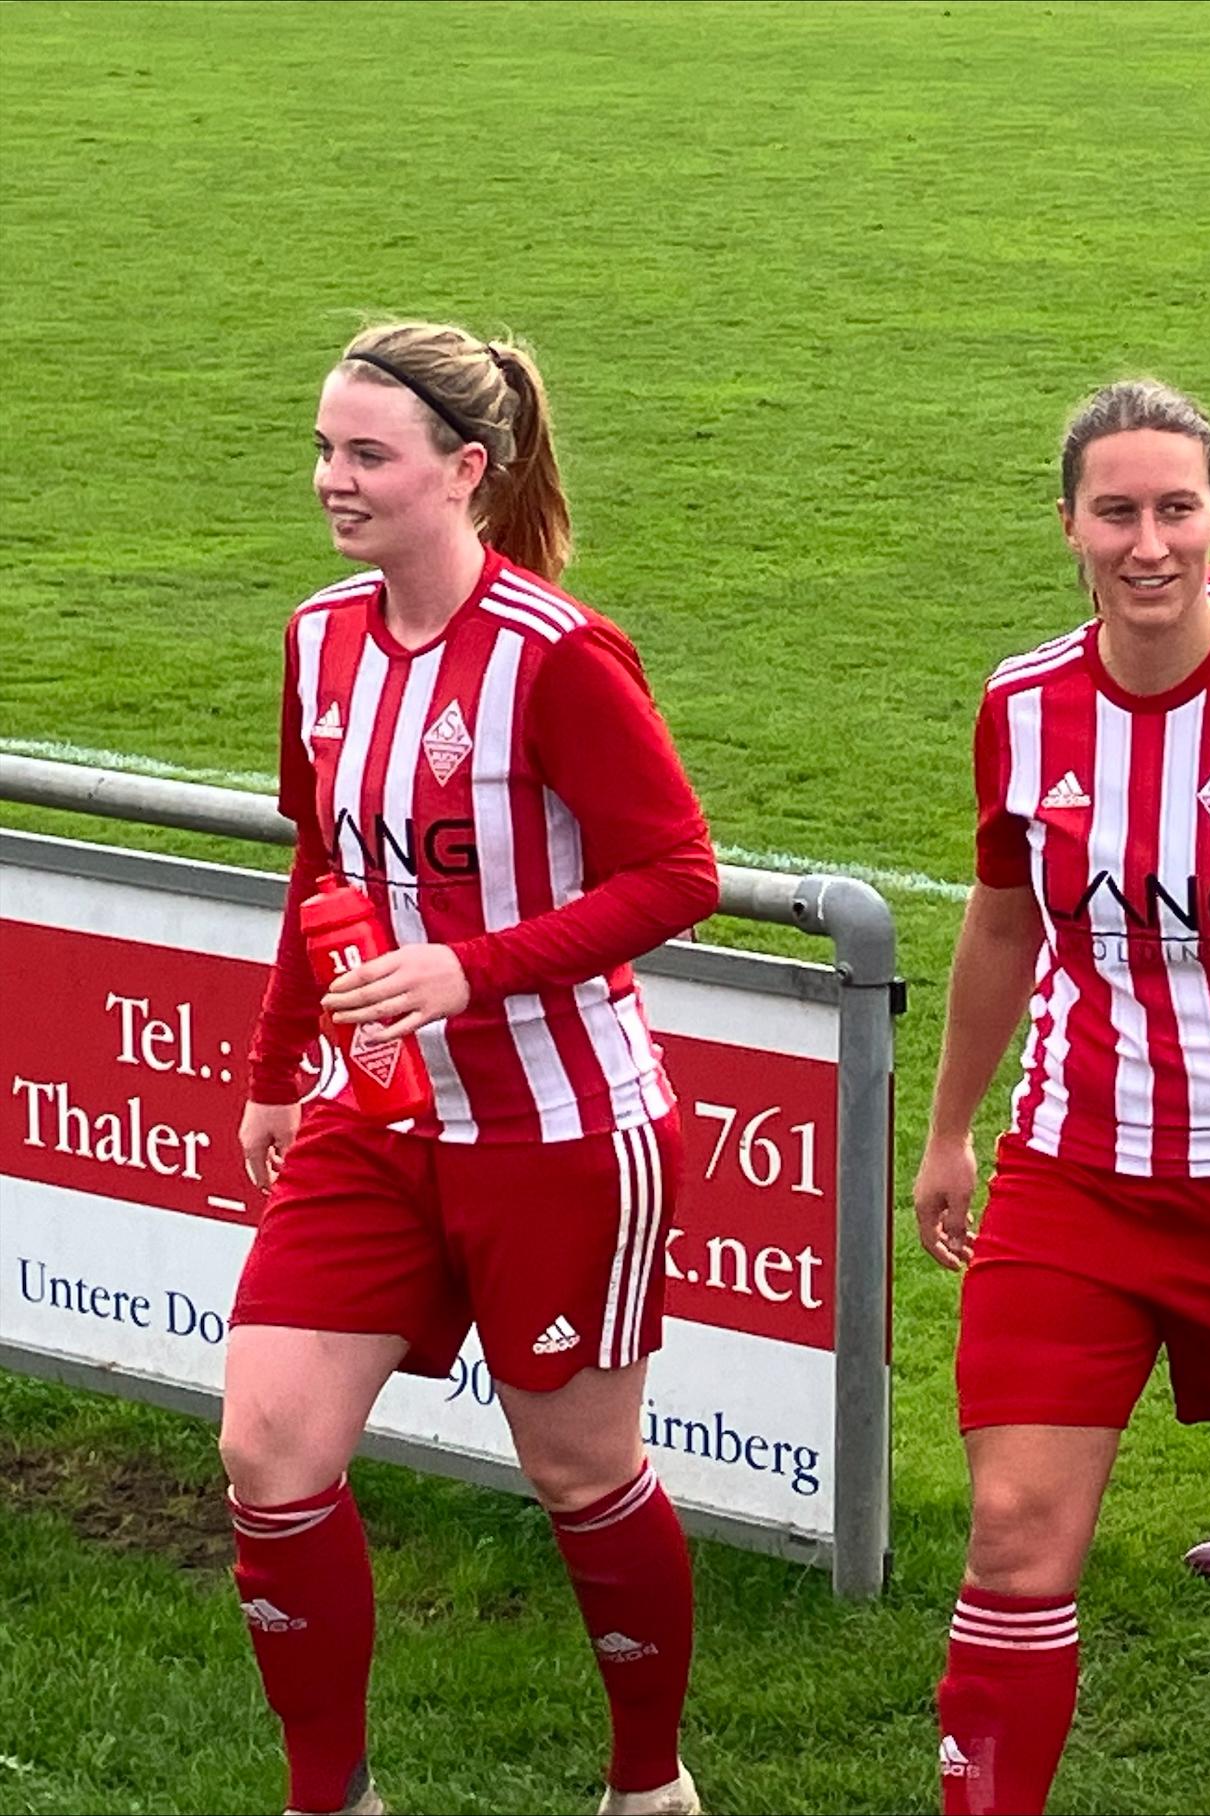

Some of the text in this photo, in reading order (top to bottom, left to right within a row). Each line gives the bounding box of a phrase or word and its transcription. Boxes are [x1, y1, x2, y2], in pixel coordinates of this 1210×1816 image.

[331, 807, 481, 882] ANG
[105, 991, 232, 1083] Tel.:
[12, 1074, 247, 1212] Thaler_
[695, 1100, 824, 1197] 761
[18, 1256, 225, 1344] Untere Do
[444, 1353, 496, 1405] 90
